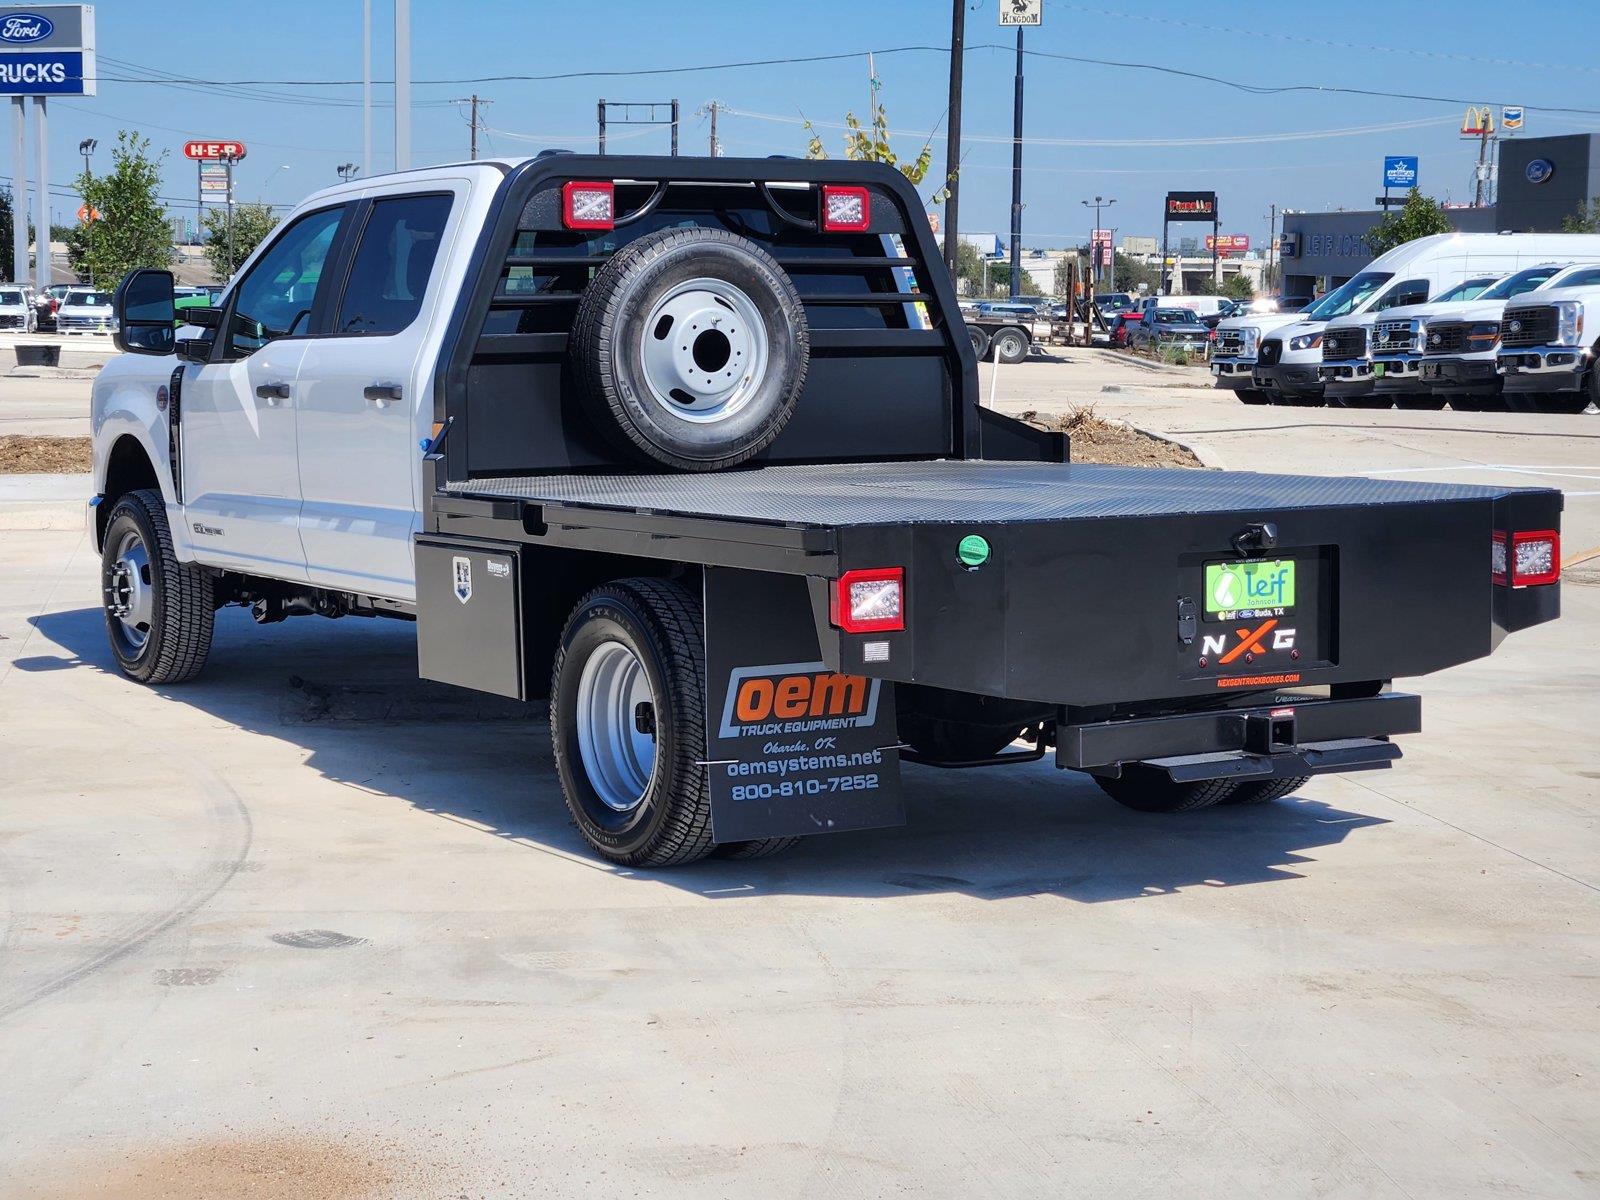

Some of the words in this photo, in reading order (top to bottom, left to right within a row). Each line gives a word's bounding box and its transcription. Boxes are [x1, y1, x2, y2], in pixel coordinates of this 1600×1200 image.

[1002, 12, 1038, 23] KINGDOM
[2, 18, 41, 37] Ford
[1273, 608, 1284, 616] TX
[1217, 674, 1300, 687] NEXGENTRUCKBODIES.COM
[737, 672, 866, 722] oem
[741, 723, 783, 737] TRUCK
[784, 717, 857, 733] EQUIPMENT
[763, 740, 810, 754] Okarche,
[815, 737, 837, 749] OK
[727, 750, 882, 777] oemsystems.net
[731, 774, 879, 801] 800-810-7252
